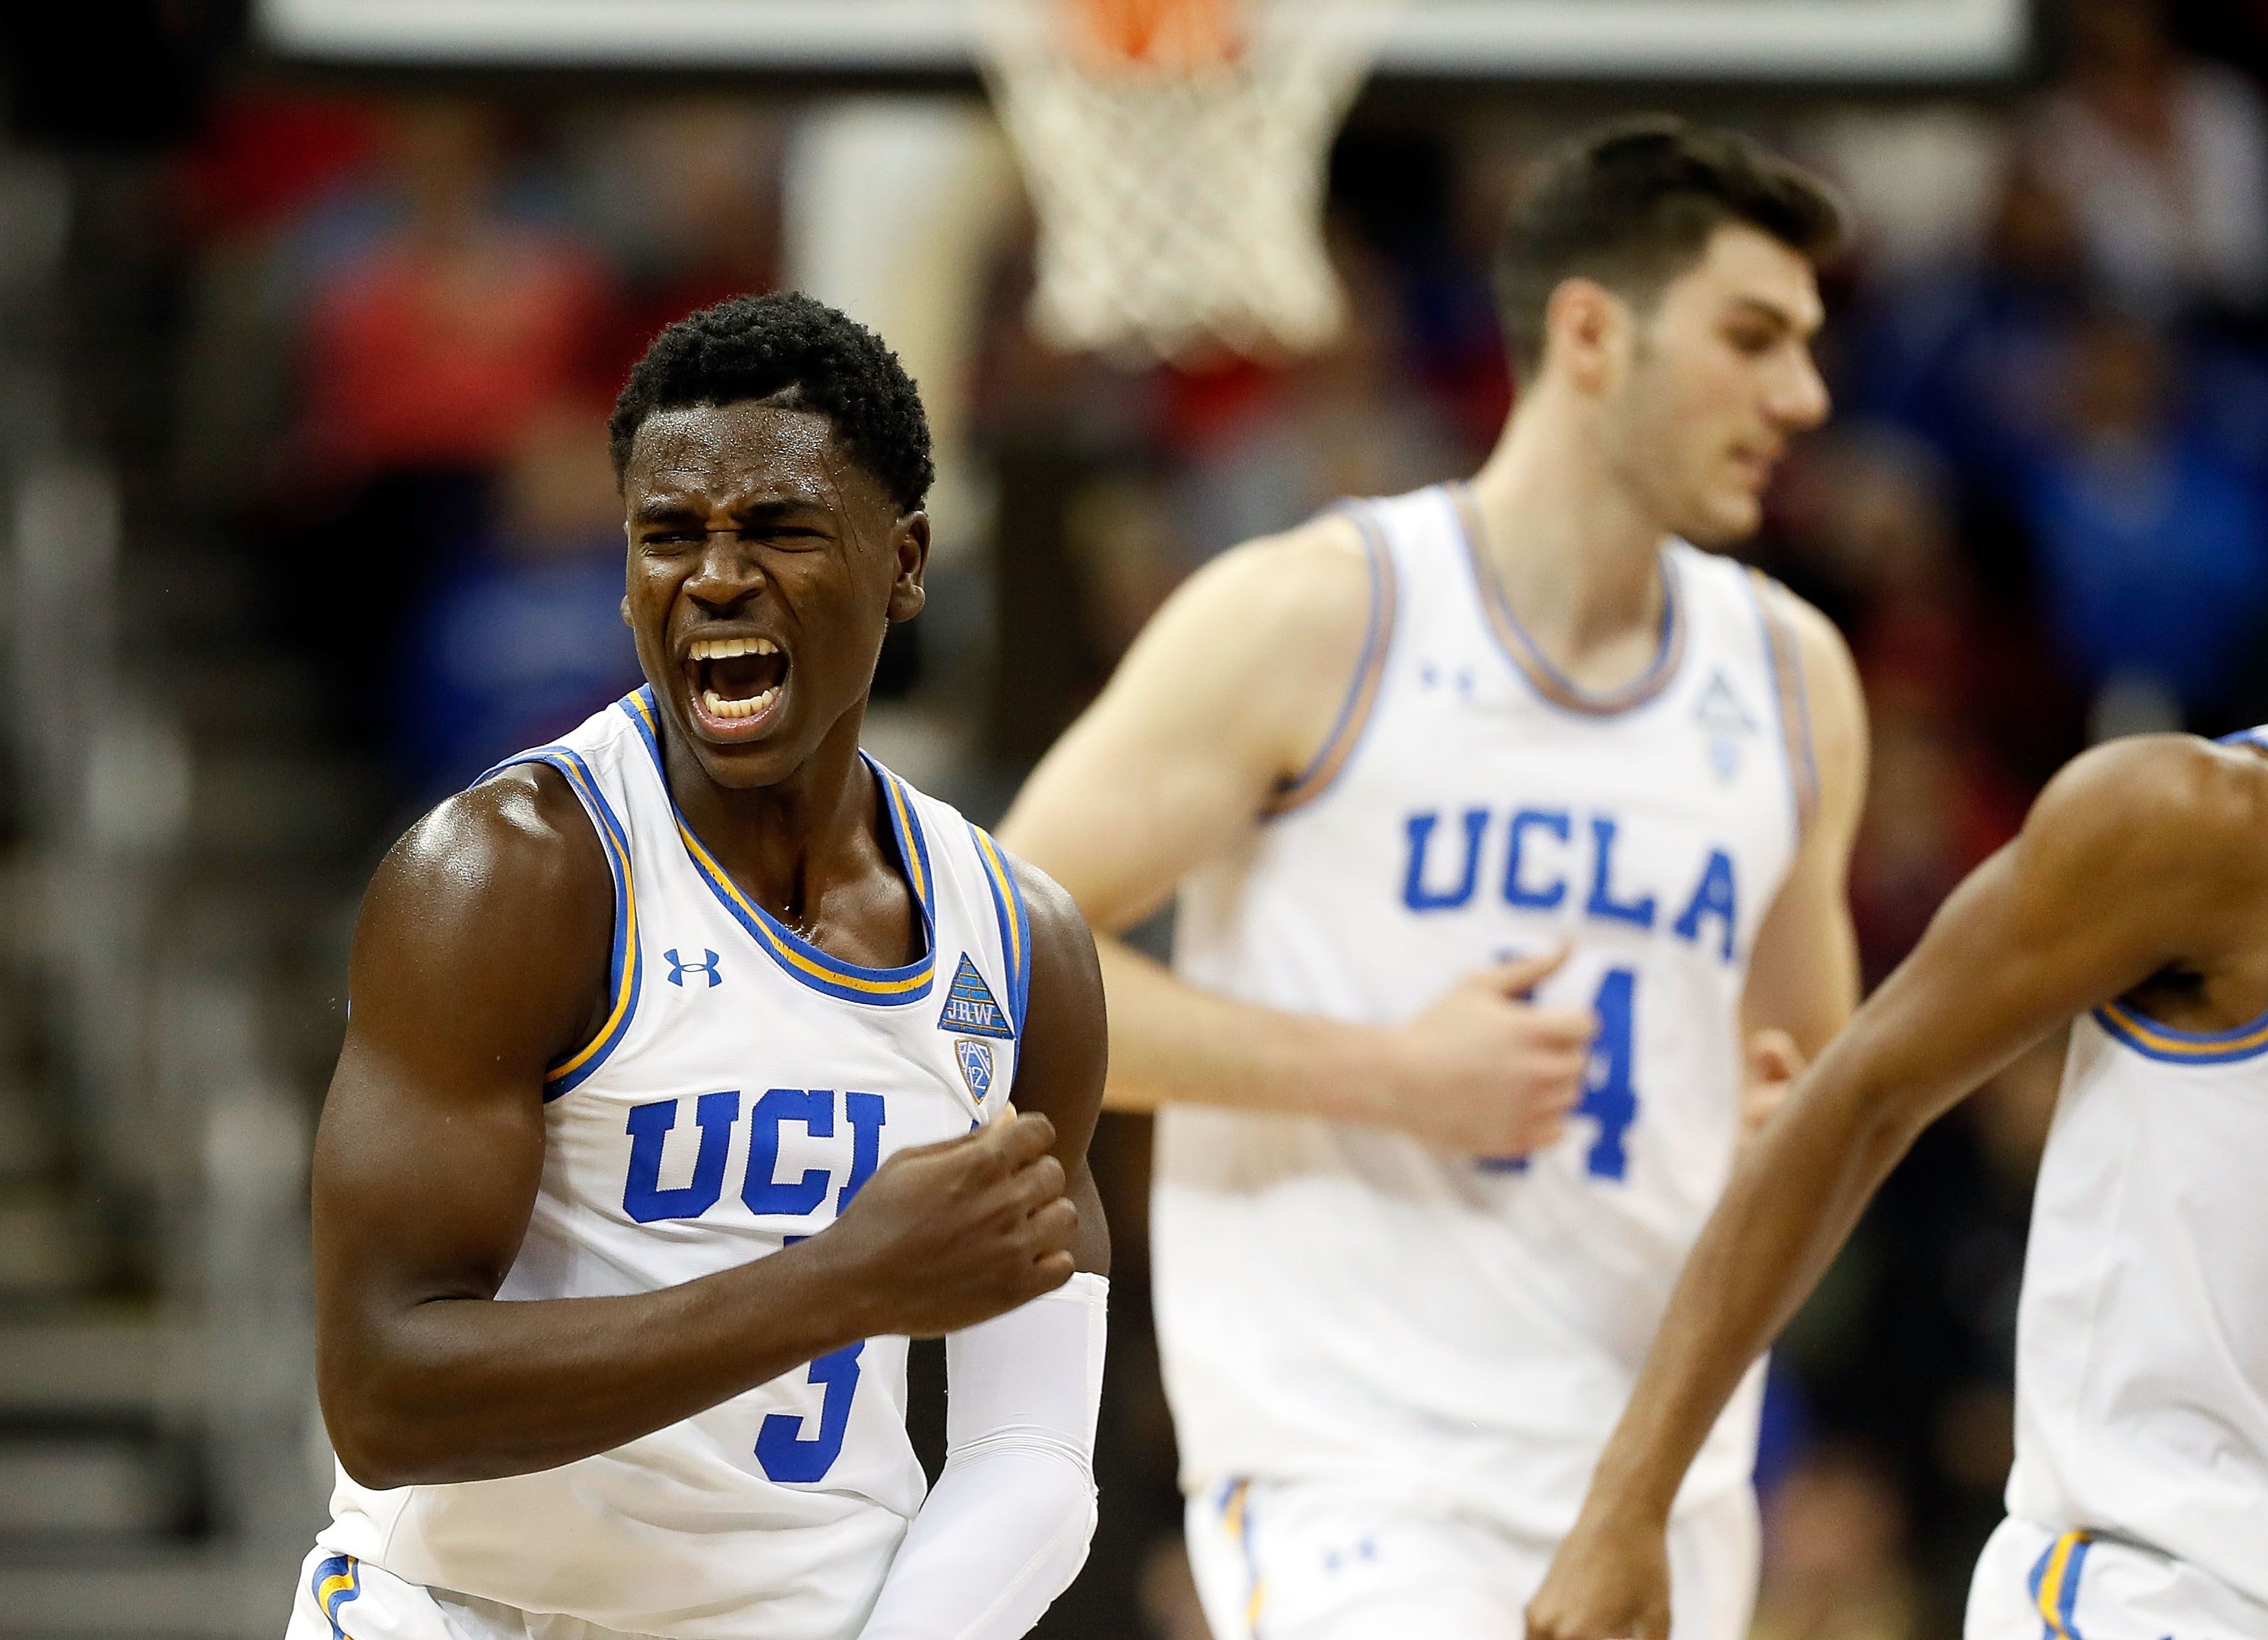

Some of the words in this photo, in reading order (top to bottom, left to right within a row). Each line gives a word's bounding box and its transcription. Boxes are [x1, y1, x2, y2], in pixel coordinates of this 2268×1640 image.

[1402, 810, 1737, 963] UCLA
[947, 1000, 994, 1025] JRW
[968, 1065, 986, 1089] 12
[623, 1089, 979, 1223] UCL
